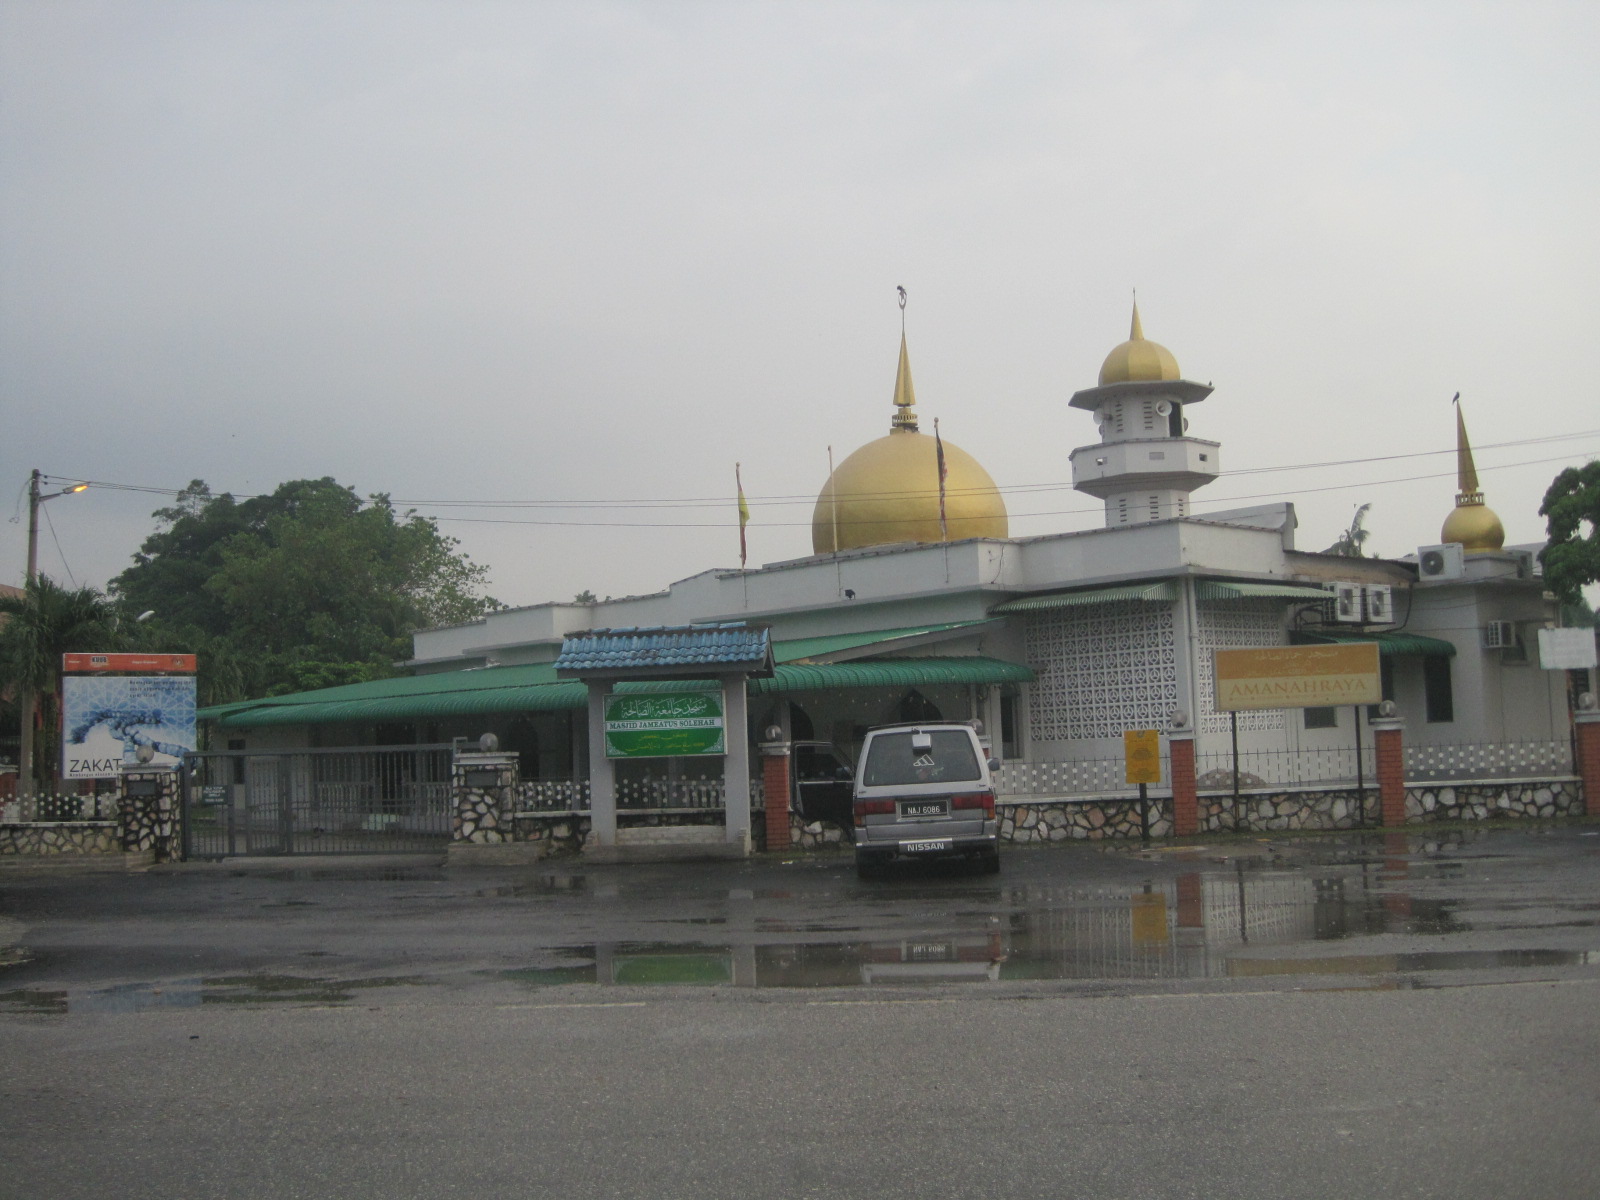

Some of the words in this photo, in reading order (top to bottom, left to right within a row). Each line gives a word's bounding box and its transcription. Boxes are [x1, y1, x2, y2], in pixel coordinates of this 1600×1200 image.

[1230, 678, 1367, 696] AMANAHRAYA
[639, 720, 678, 729] JAMEATUS
[69, 758, 122, 773] ZAKAT
[907, 842, 945, 851] NISSAN
